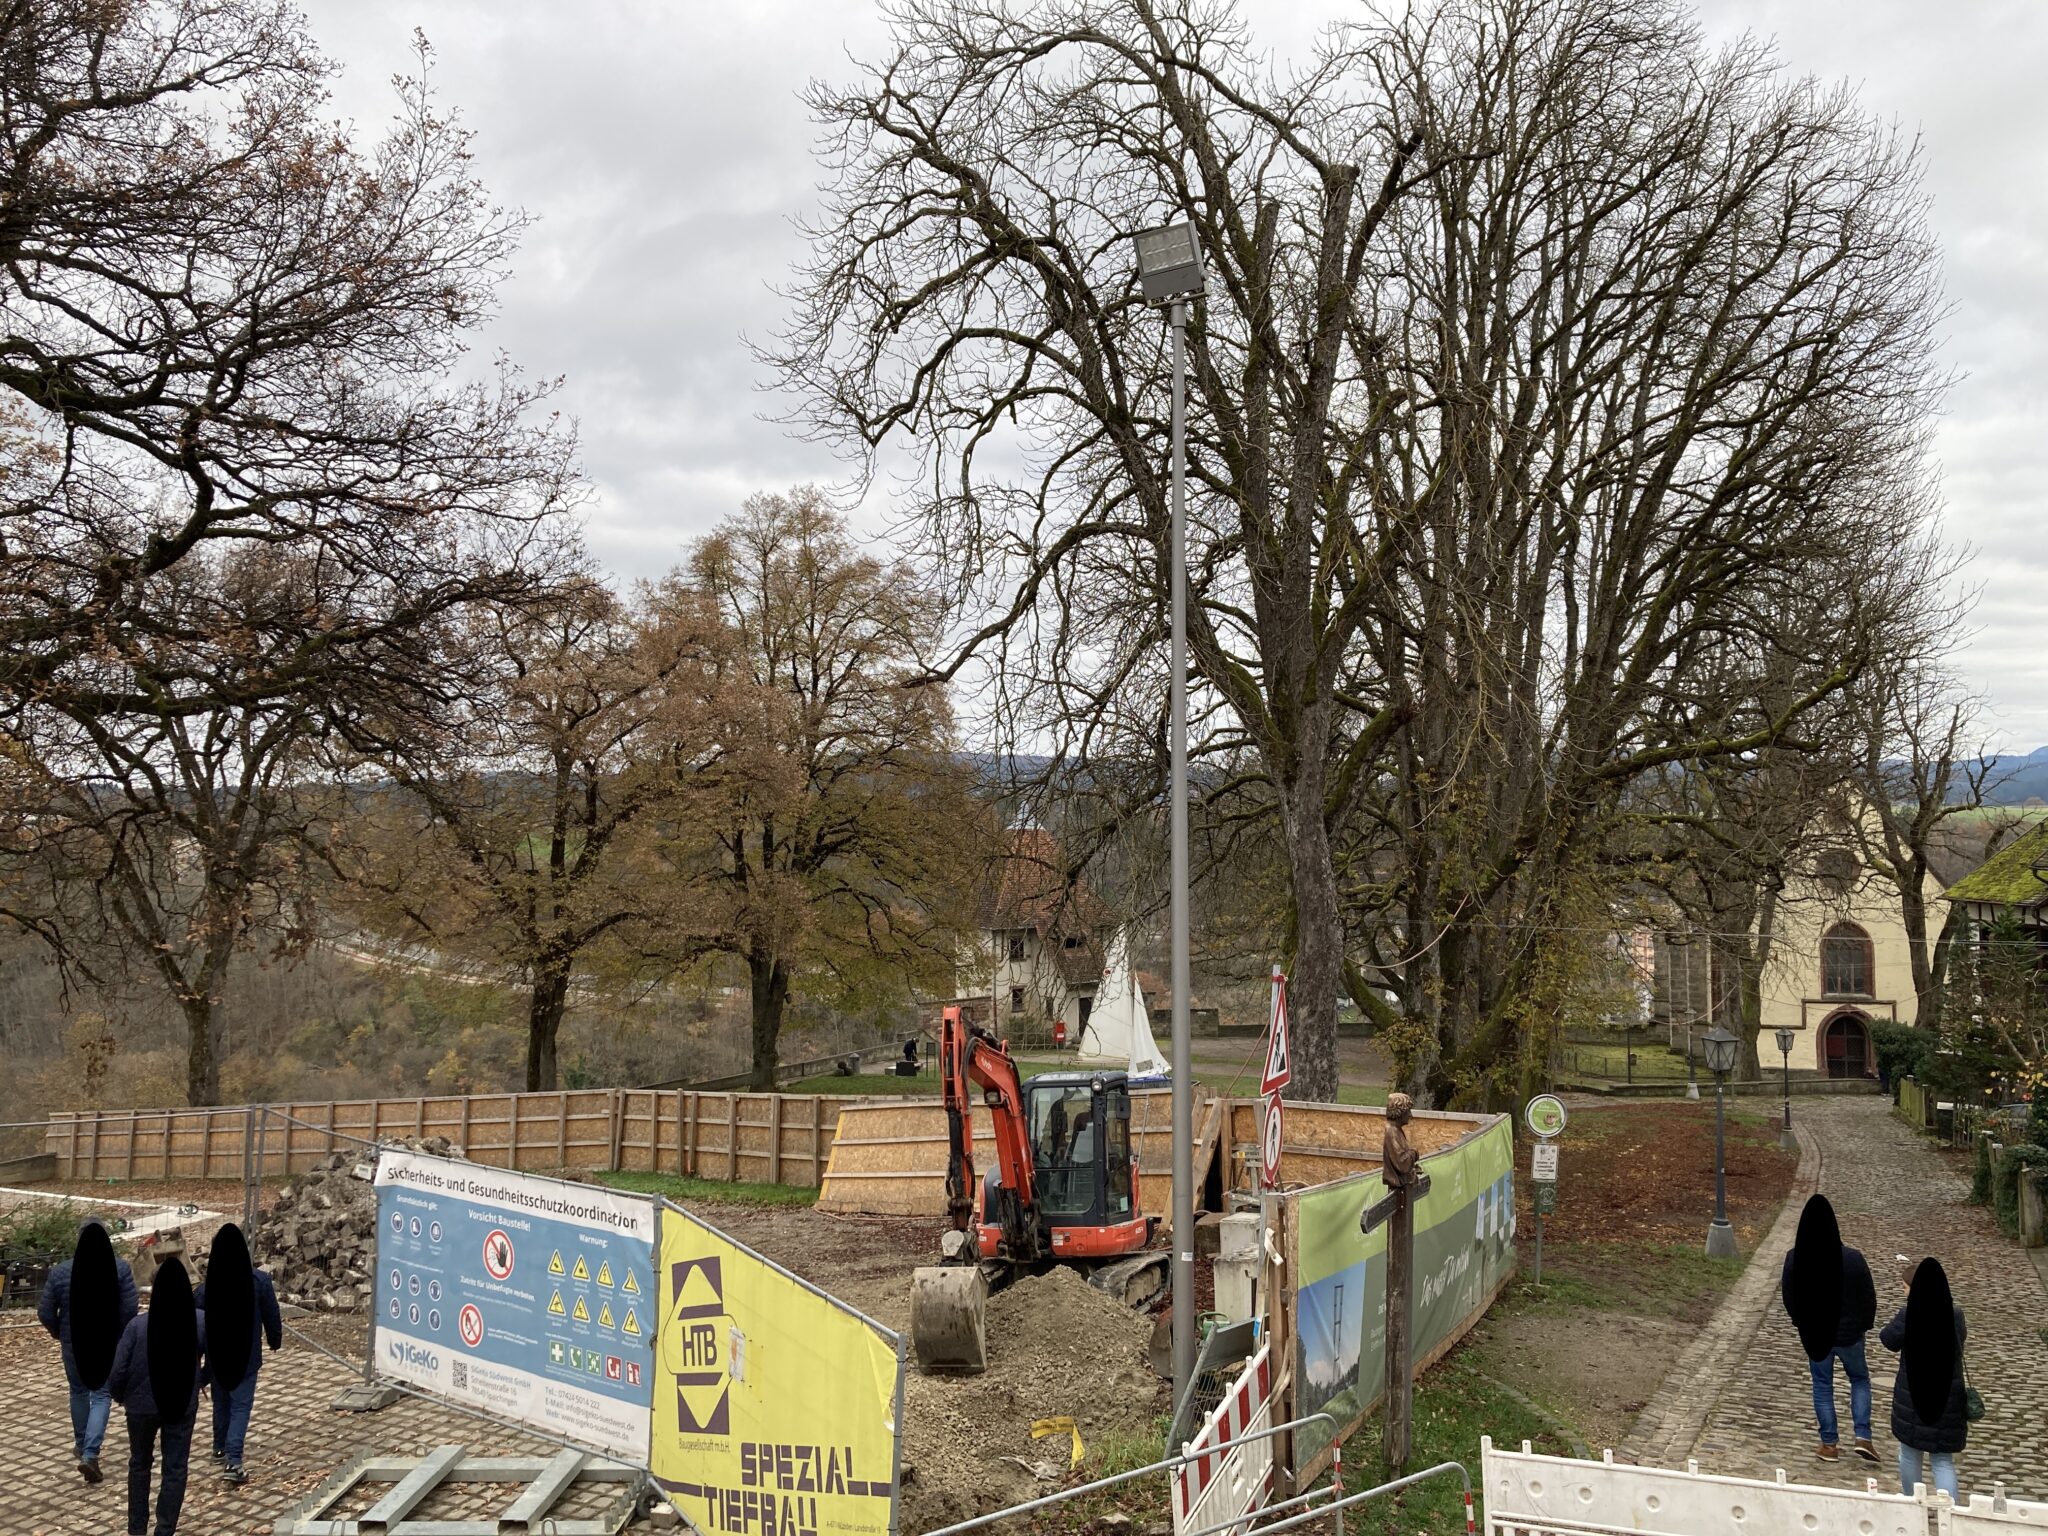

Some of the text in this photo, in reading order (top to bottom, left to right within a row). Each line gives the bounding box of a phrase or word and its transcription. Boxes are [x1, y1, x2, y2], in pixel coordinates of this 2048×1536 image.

[388, 1167, 639, 1231] Sicherheits- und Gesundheitsschutzkoordination
[468, 1208, 531, 1232] Vorsicht Baustelle!
[681, 1324, 717, 1367] HTB
[741, 1442, 869, 1496] SPEZIAL
[703, 1484, 818, 1536] TIEFBAU
